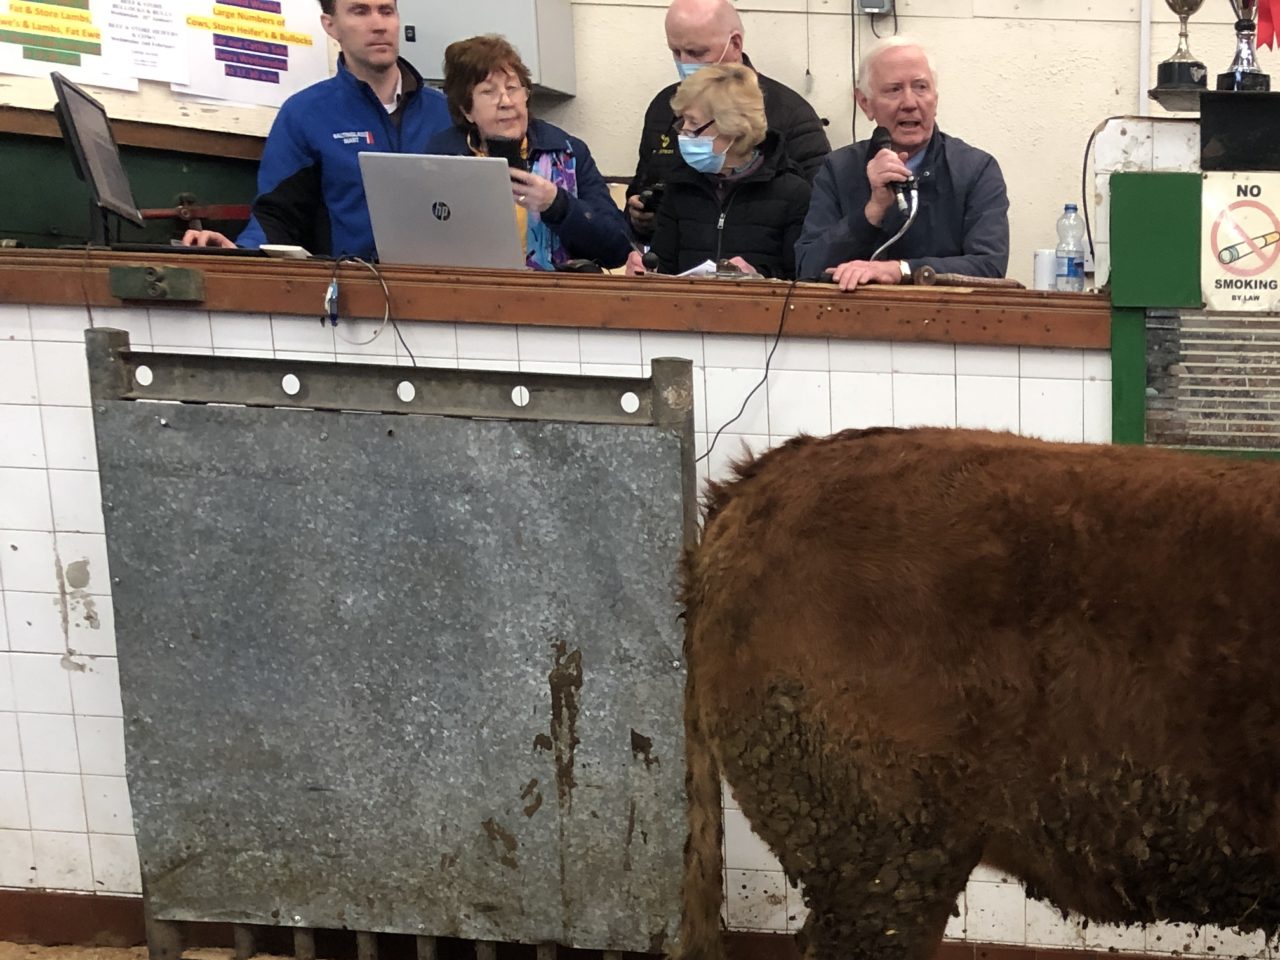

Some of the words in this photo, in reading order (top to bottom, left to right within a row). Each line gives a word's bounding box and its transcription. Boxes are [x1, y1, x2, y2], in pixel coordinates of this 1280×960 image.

[9, 3, 23, 13] Fat
[25, 6, 32, 14] &
[34, 7, 58, 18] Store
[213, 7, 235, 19] Large
[237, 12, 275, 25] Numbers
[277, 19, 286, 27] of
[22, 20, 29, 28] &
[66, 27, 79, 36] Fat
[82, 29, 101, 39] Ewe
[186, 17, 211, 29] Cows,
[213, 22, 235, 32] Store
[237, 26, 268, 38] Heifer's
[271, 31, 278, 39] &
[280, 33, 313, 46] Bullocks
[1237, 185, 1261, 197] NO
[433, 202, 450, 221] hp
[1214, 279, 1278, 290] SMOKING
